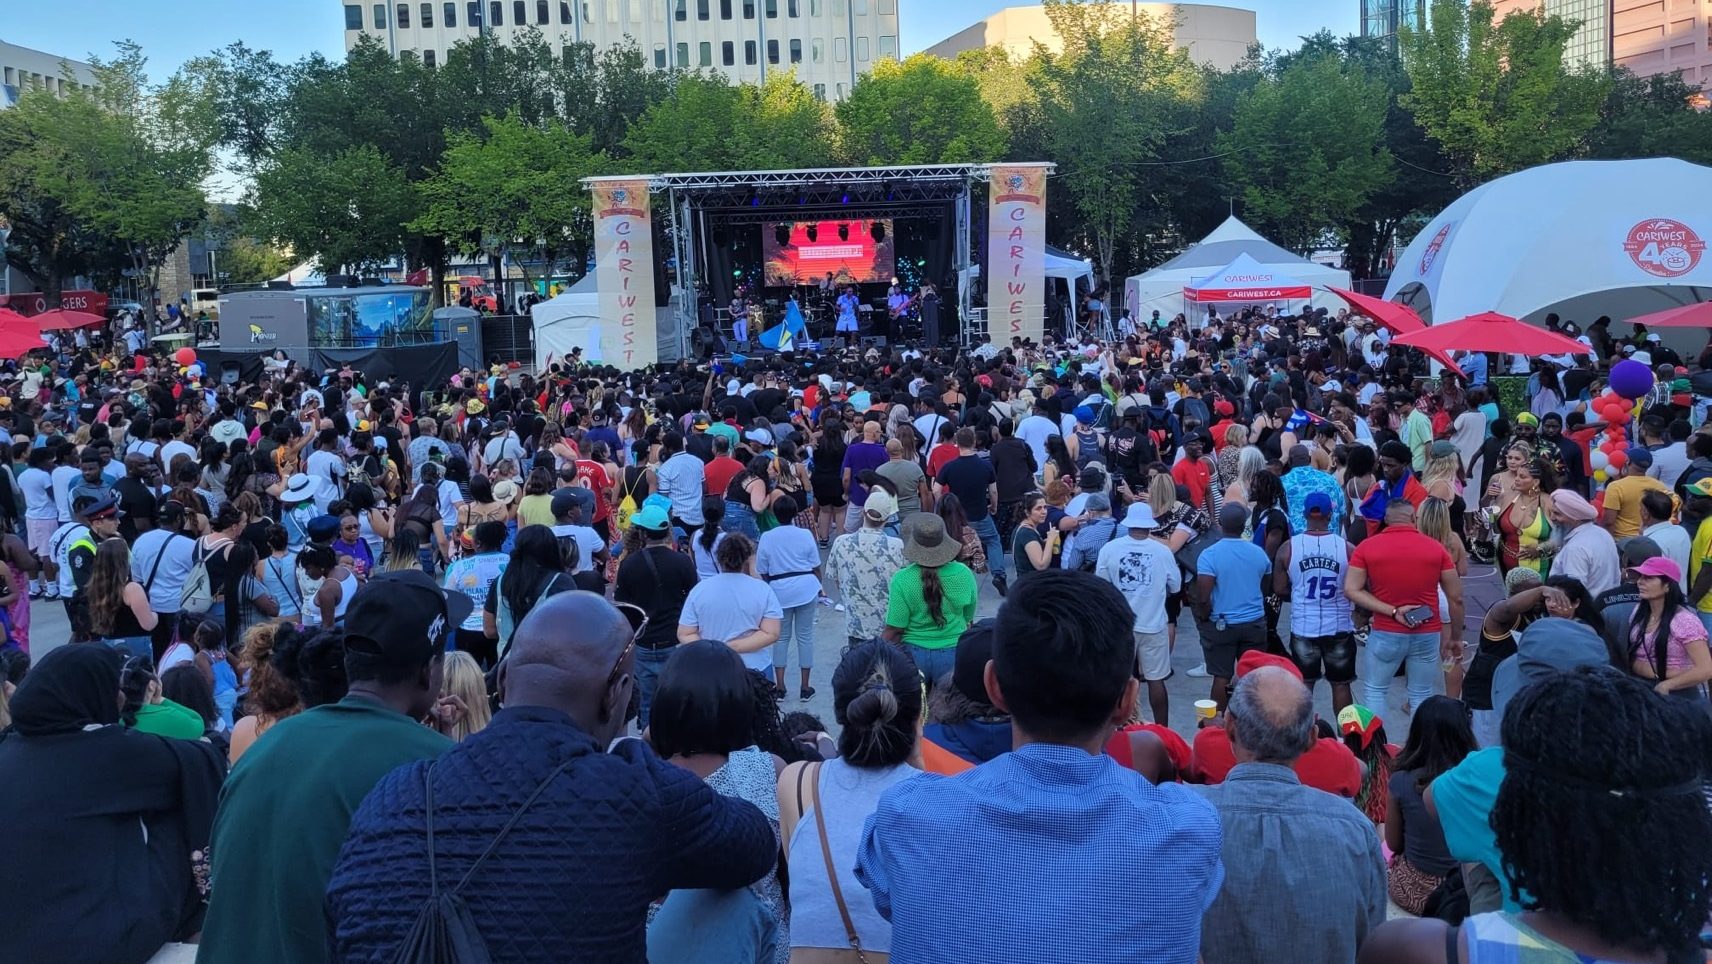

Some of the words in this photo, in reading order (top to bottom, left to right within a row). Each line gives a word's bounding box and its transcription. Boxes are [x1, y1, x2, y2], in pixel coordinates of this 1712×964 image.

[1636, 231, 1686, 241] CARIWEST
[1007, 208, 1026, 341] CARIWES
[1224, 274, 1273, 283] CARIWEST
[615, 222, 636, 364] CARIWEST
[1227, 290, 1282, 298] CARIWEST.CA
[1301, 557, 1337, 571] CARTER
[1305, 575, 1337, 600] 15
